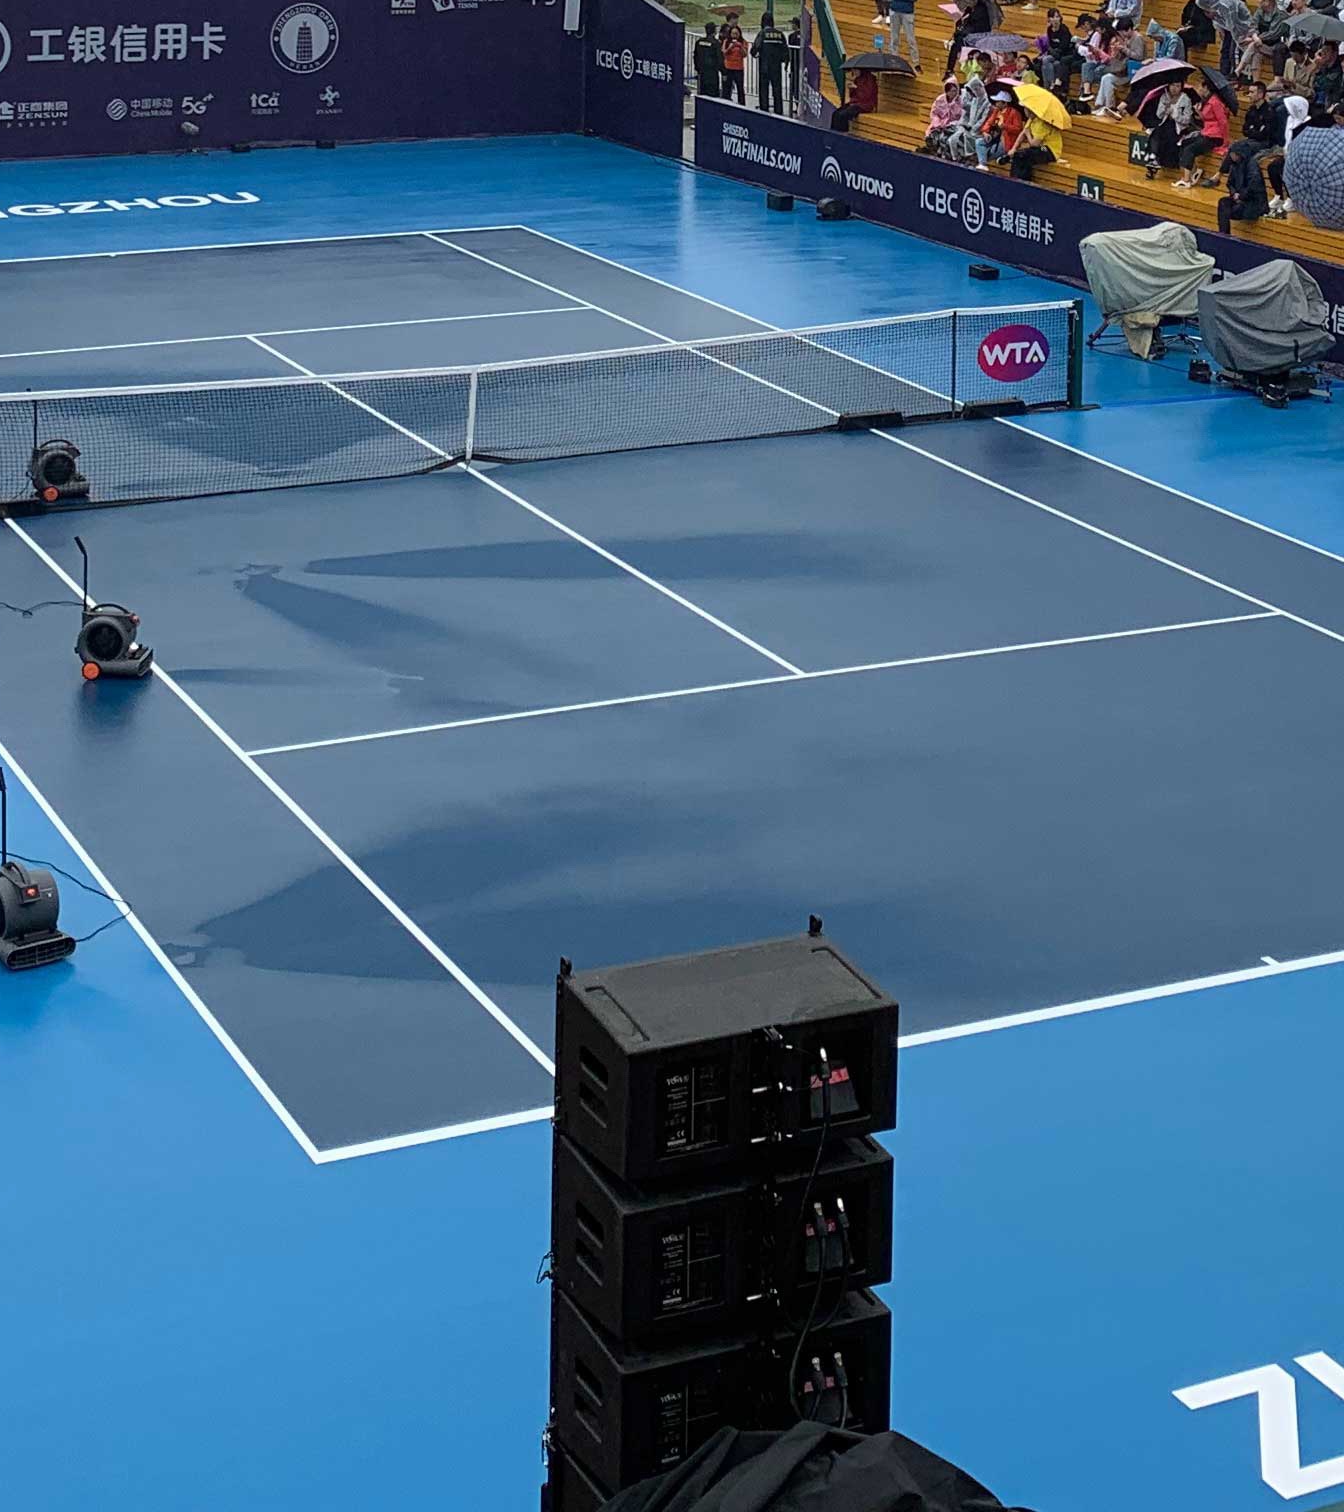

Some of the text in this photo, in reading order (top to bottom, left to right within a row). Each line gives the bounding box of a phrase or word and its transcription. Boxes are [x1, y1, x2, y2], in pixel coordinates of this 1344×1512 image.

[27, 21, 226, 65] 工银信用卡
[596, 49, 619, 70] ICBC
[17, 112, 68, 120] ZENSUN
[722, 135, 802, 175] WTAFINALS.COM
[844, 170, 894, 200] YUTONG
[1081, 183, 1099, 200] A-1
[920, 184, 1055, 245] ICBC 工银信用卡
[982, 340, 1046, 367] WTA
